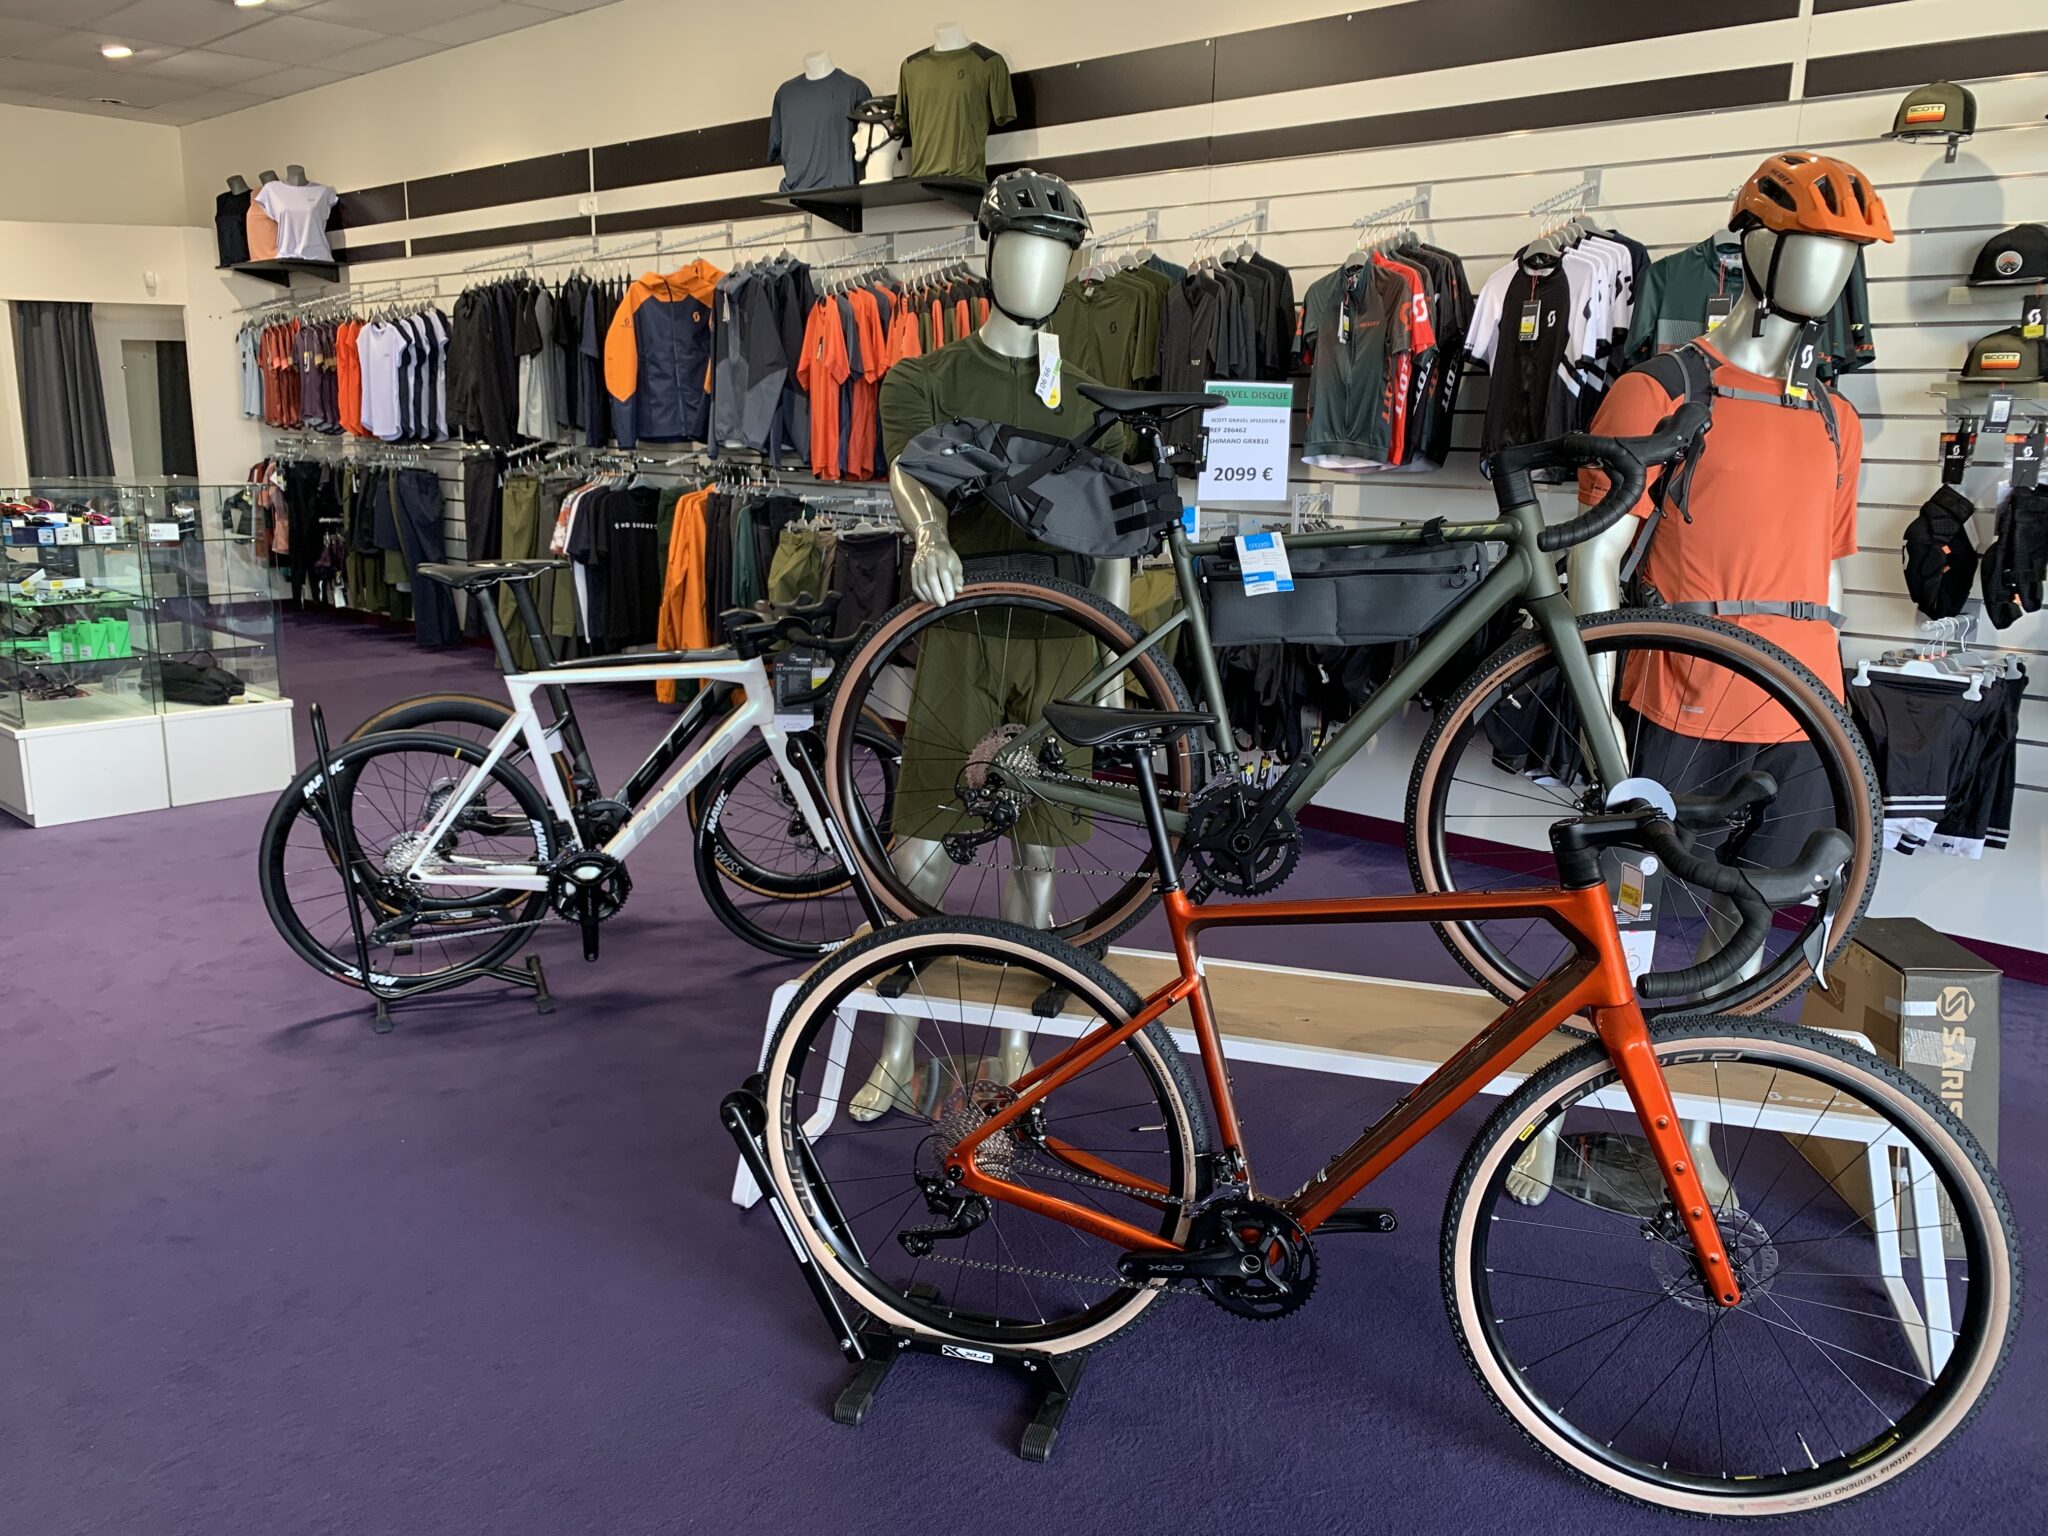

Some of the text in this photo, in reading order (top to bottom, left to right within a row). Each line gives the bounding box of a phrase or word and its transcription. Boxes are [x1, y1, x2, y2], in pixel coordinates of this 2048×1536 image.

[1909, 105, 1944, 113] SCOTT
[1251, 391, 1289, 400] DISQUE
[1213, 467, 1273, 482] 2099 €
[303, 759, 345, 799] MAIC
[633, 732, 734, 841] ADRIS
[1271, 771, 1298, 806] PRAXIS
[706, 789, 729, 834] MAVIC
[530, 819, 549, 861] MAVIC
[714, 845, 745, 876] SWISS
[344, 966, 400, 987] MAIC
[1148, 1264, 1185, 1272] GRX
[1834, 1473, 1878, 1495] TERRENO
[1812, 1490, 1833, 1503] DRY
